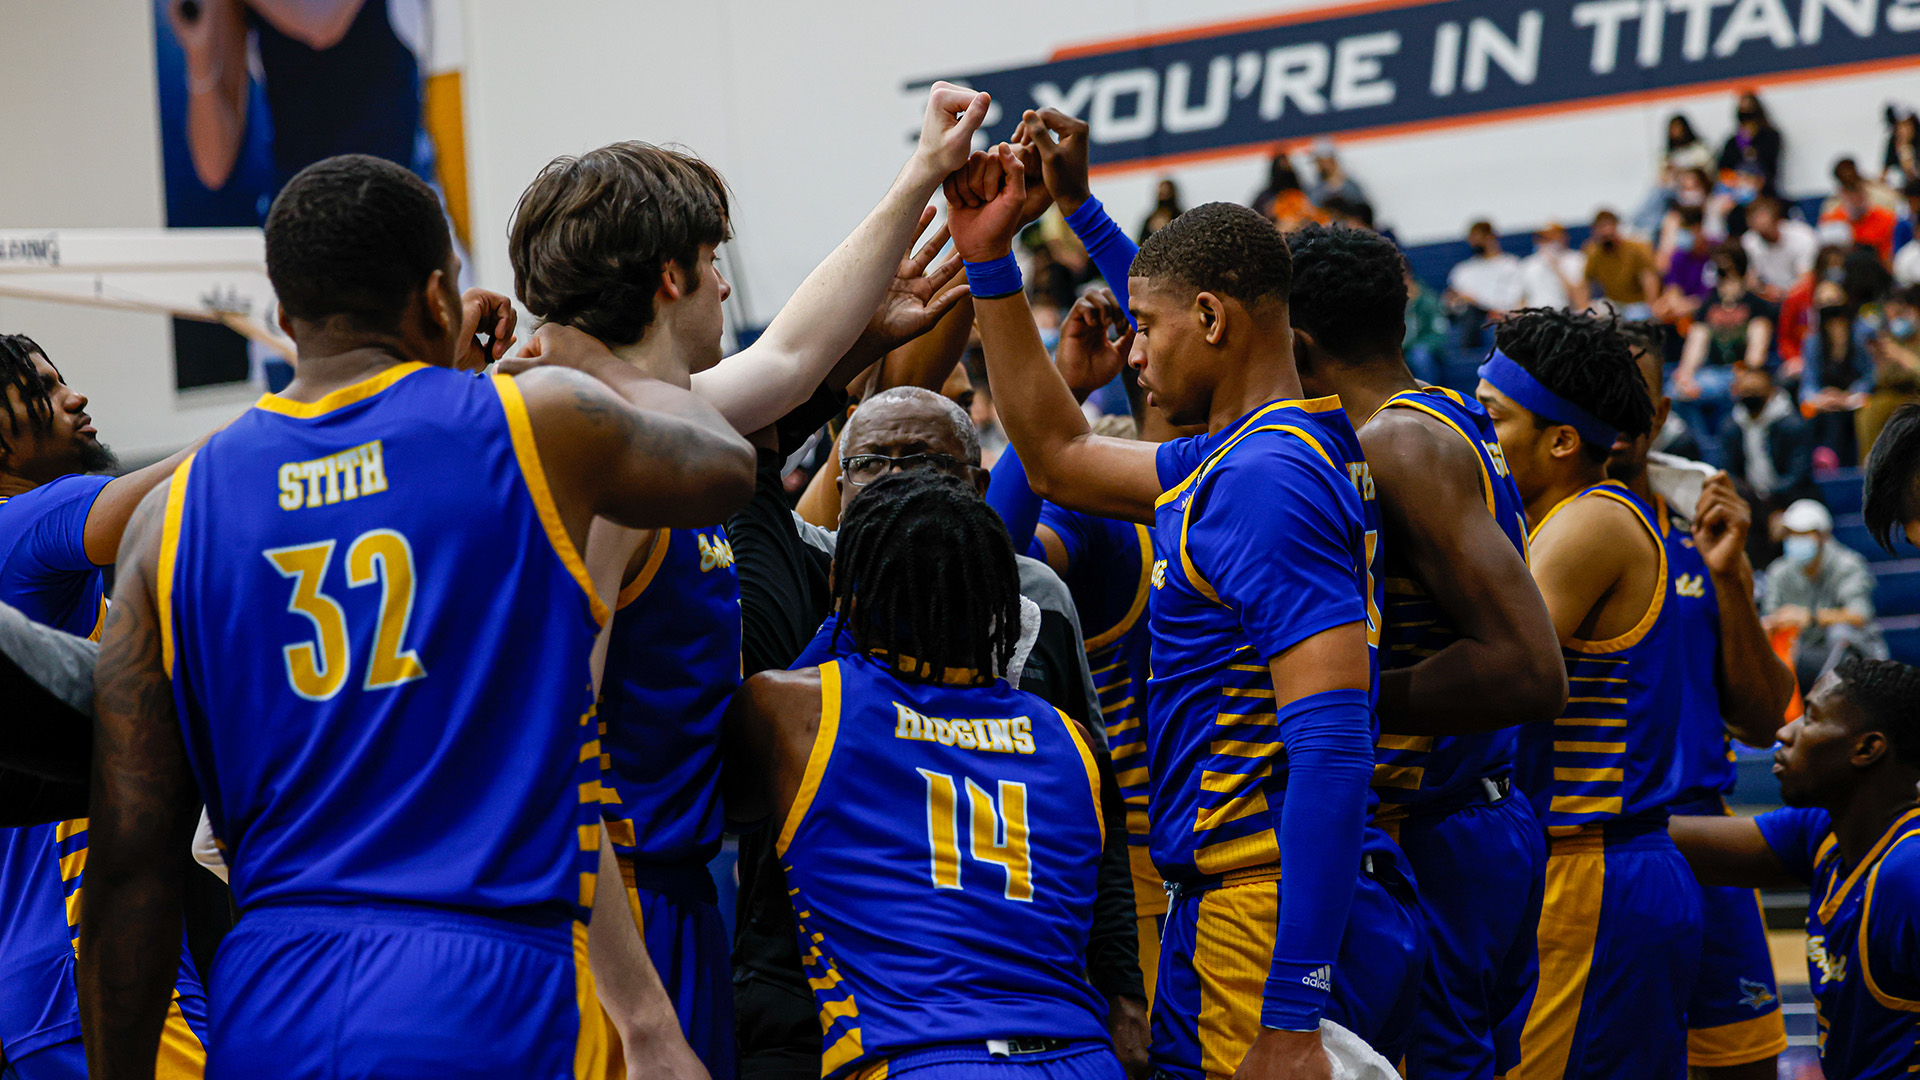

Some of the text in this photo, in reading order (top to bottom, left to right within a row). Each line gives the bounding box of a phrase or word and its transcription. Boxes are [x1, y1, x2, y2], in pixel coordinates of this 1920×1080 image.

[1430, 10, 1544, 96] IN
[278, 439, 389, 511] STITH
[262, 528, 428, 702] 32
[915, 766, 1035, 903] 14
